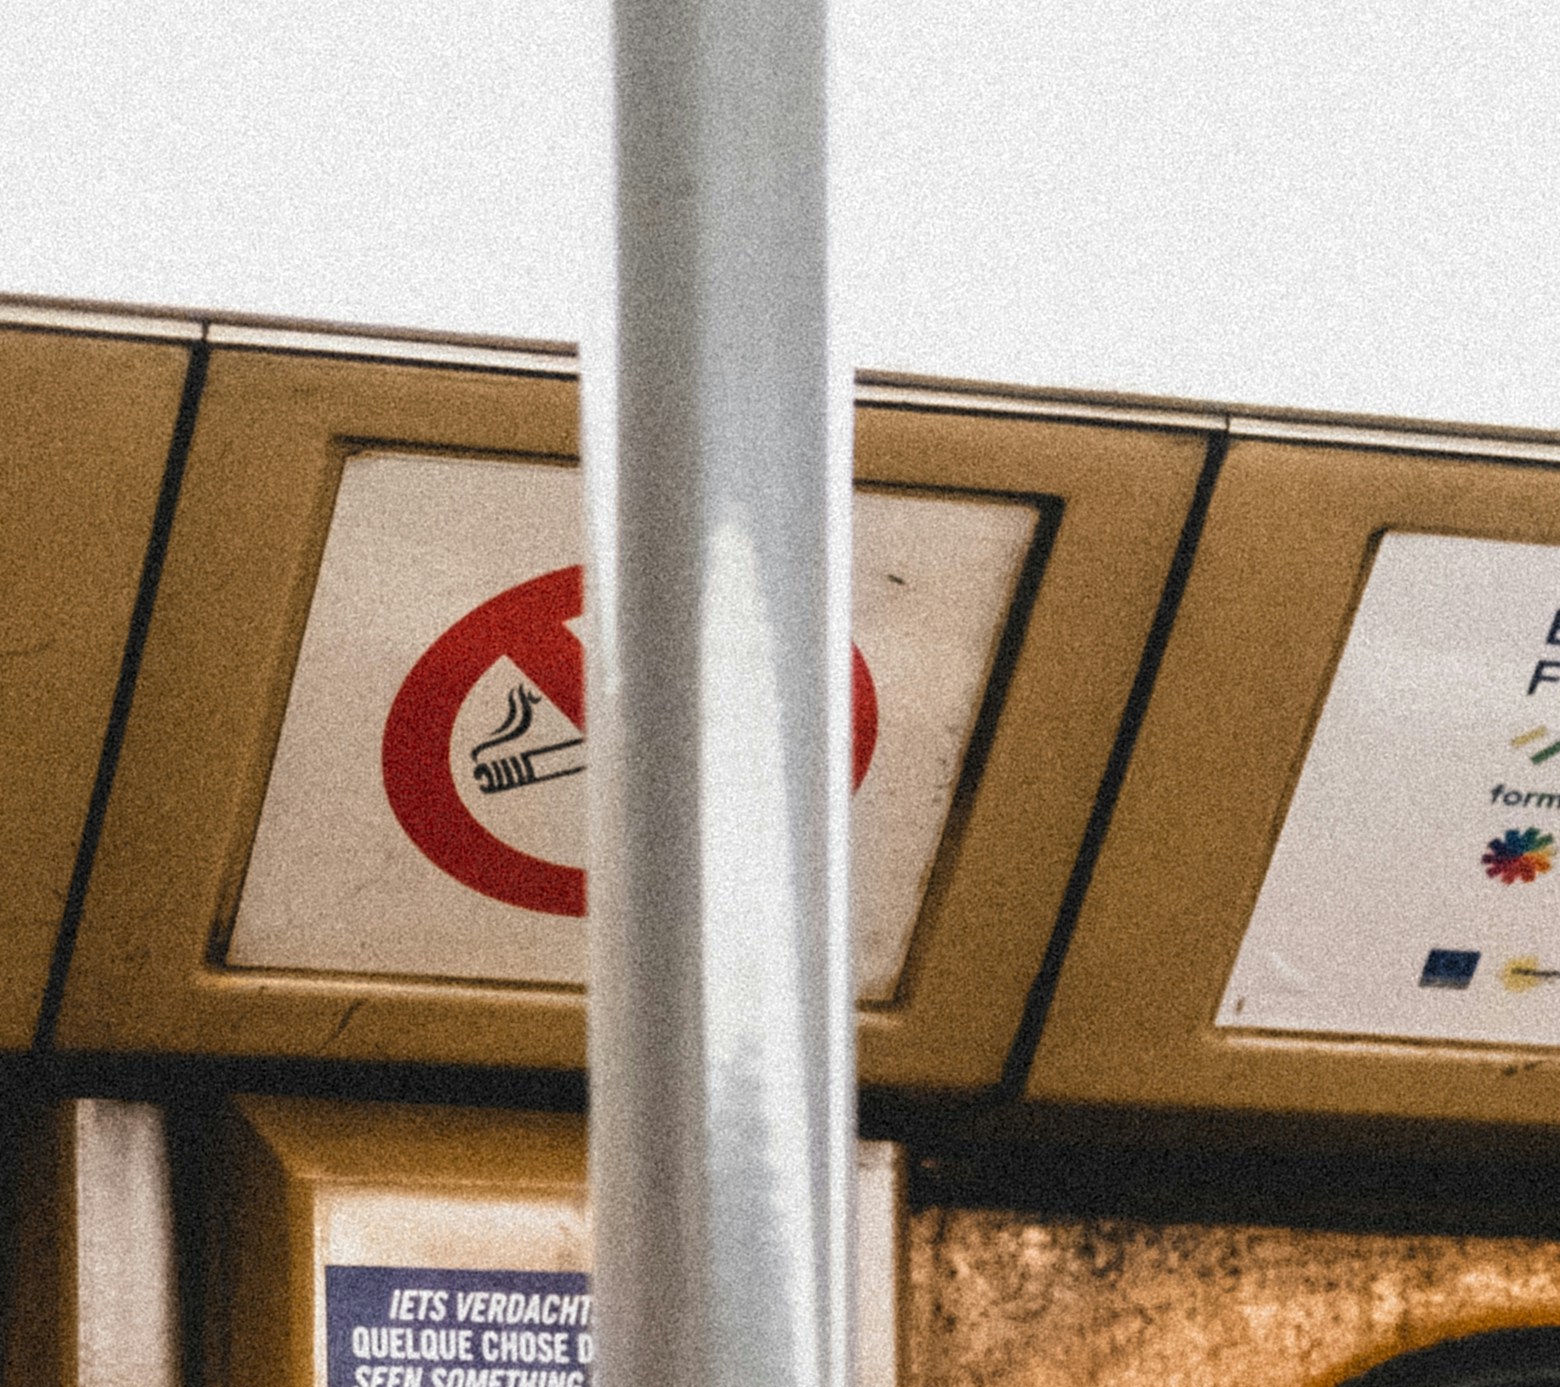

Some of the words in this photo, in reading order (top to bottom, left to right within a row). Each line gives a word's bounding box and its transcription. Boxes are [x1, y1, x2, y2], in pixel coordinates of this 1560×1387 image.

[389, 1288, 449, 1322] IETS
[456, 1291, 594, 1326] VERDACHT
[352, 1326, 474, 1361] QUELQUE
[481, 1330, 571, 1364] CHOSE
